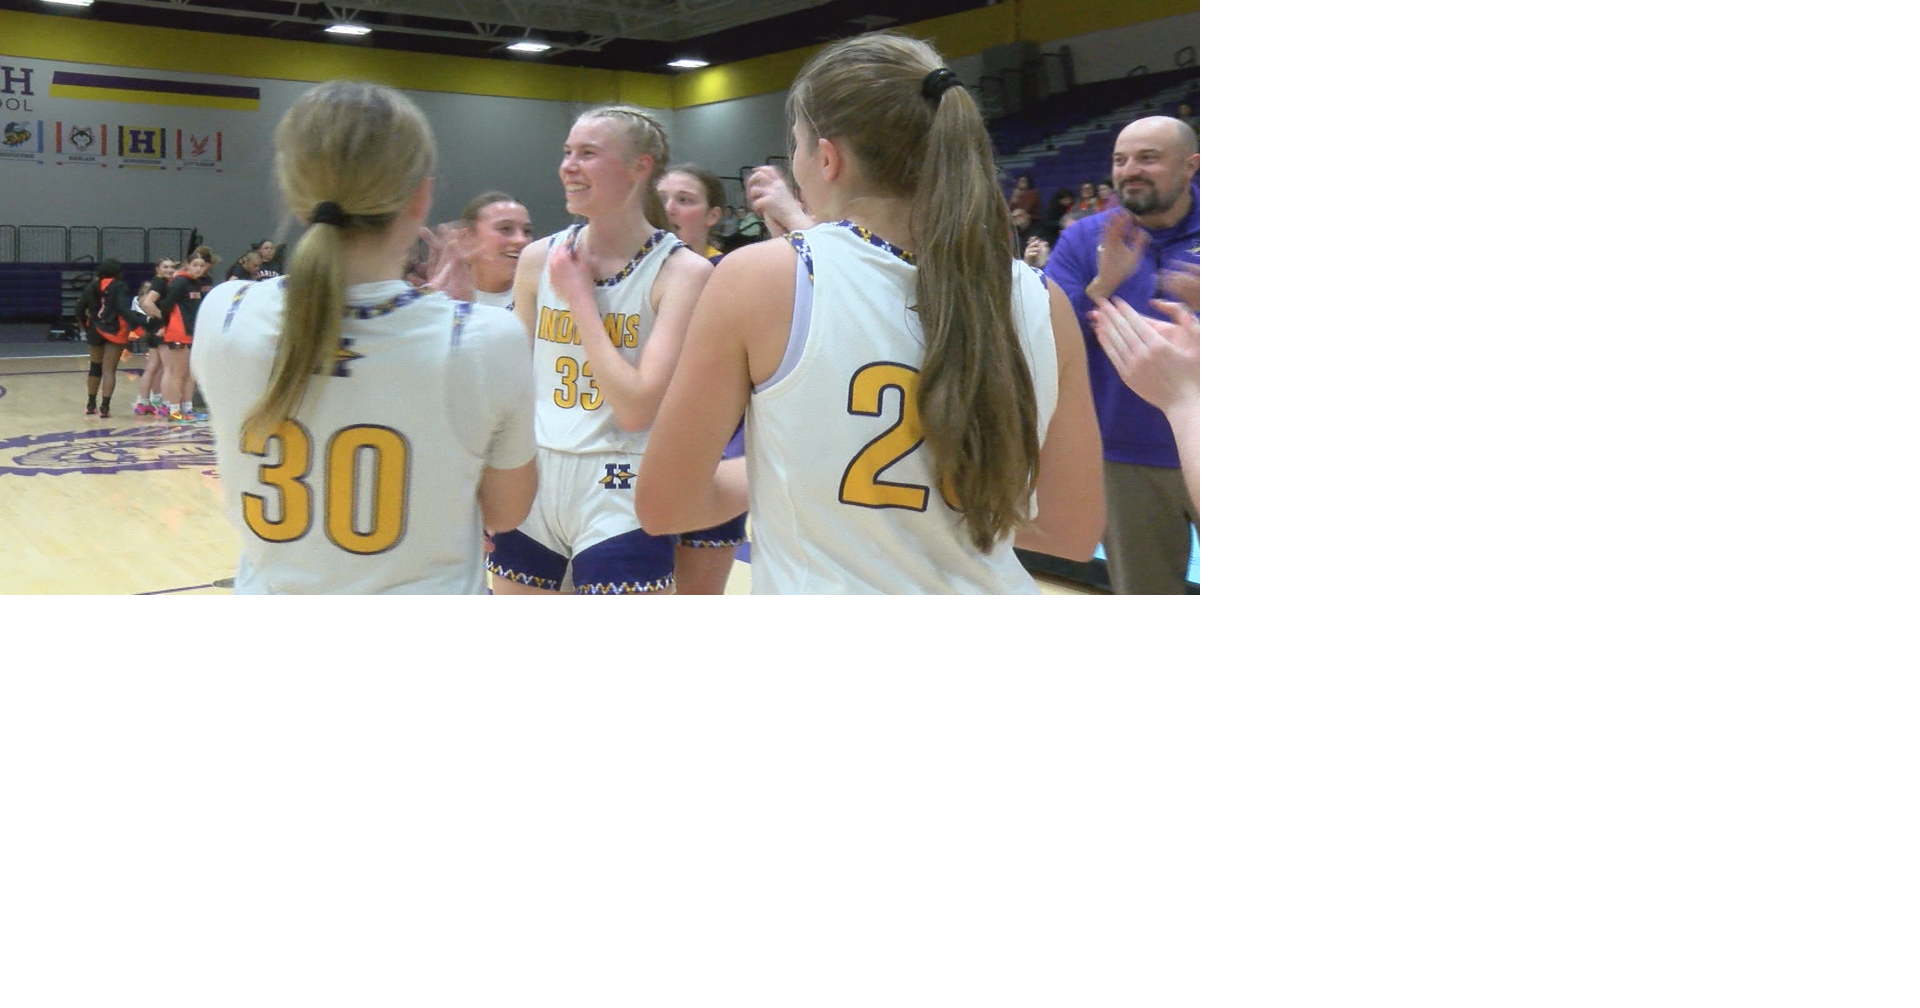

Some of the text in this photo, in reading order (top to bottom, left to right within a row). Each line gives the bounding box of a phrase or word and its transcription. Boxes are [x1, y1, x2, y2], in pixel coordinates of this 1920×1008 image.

[0, 97, 33, 112] OL
[128, 129, 156, 154] H
[538, 305, 640, 348] INDINS
[553, 355, 606, 411] 33
[838, 360, 968, 513] 2
[239, 416, 413, 556] 30
